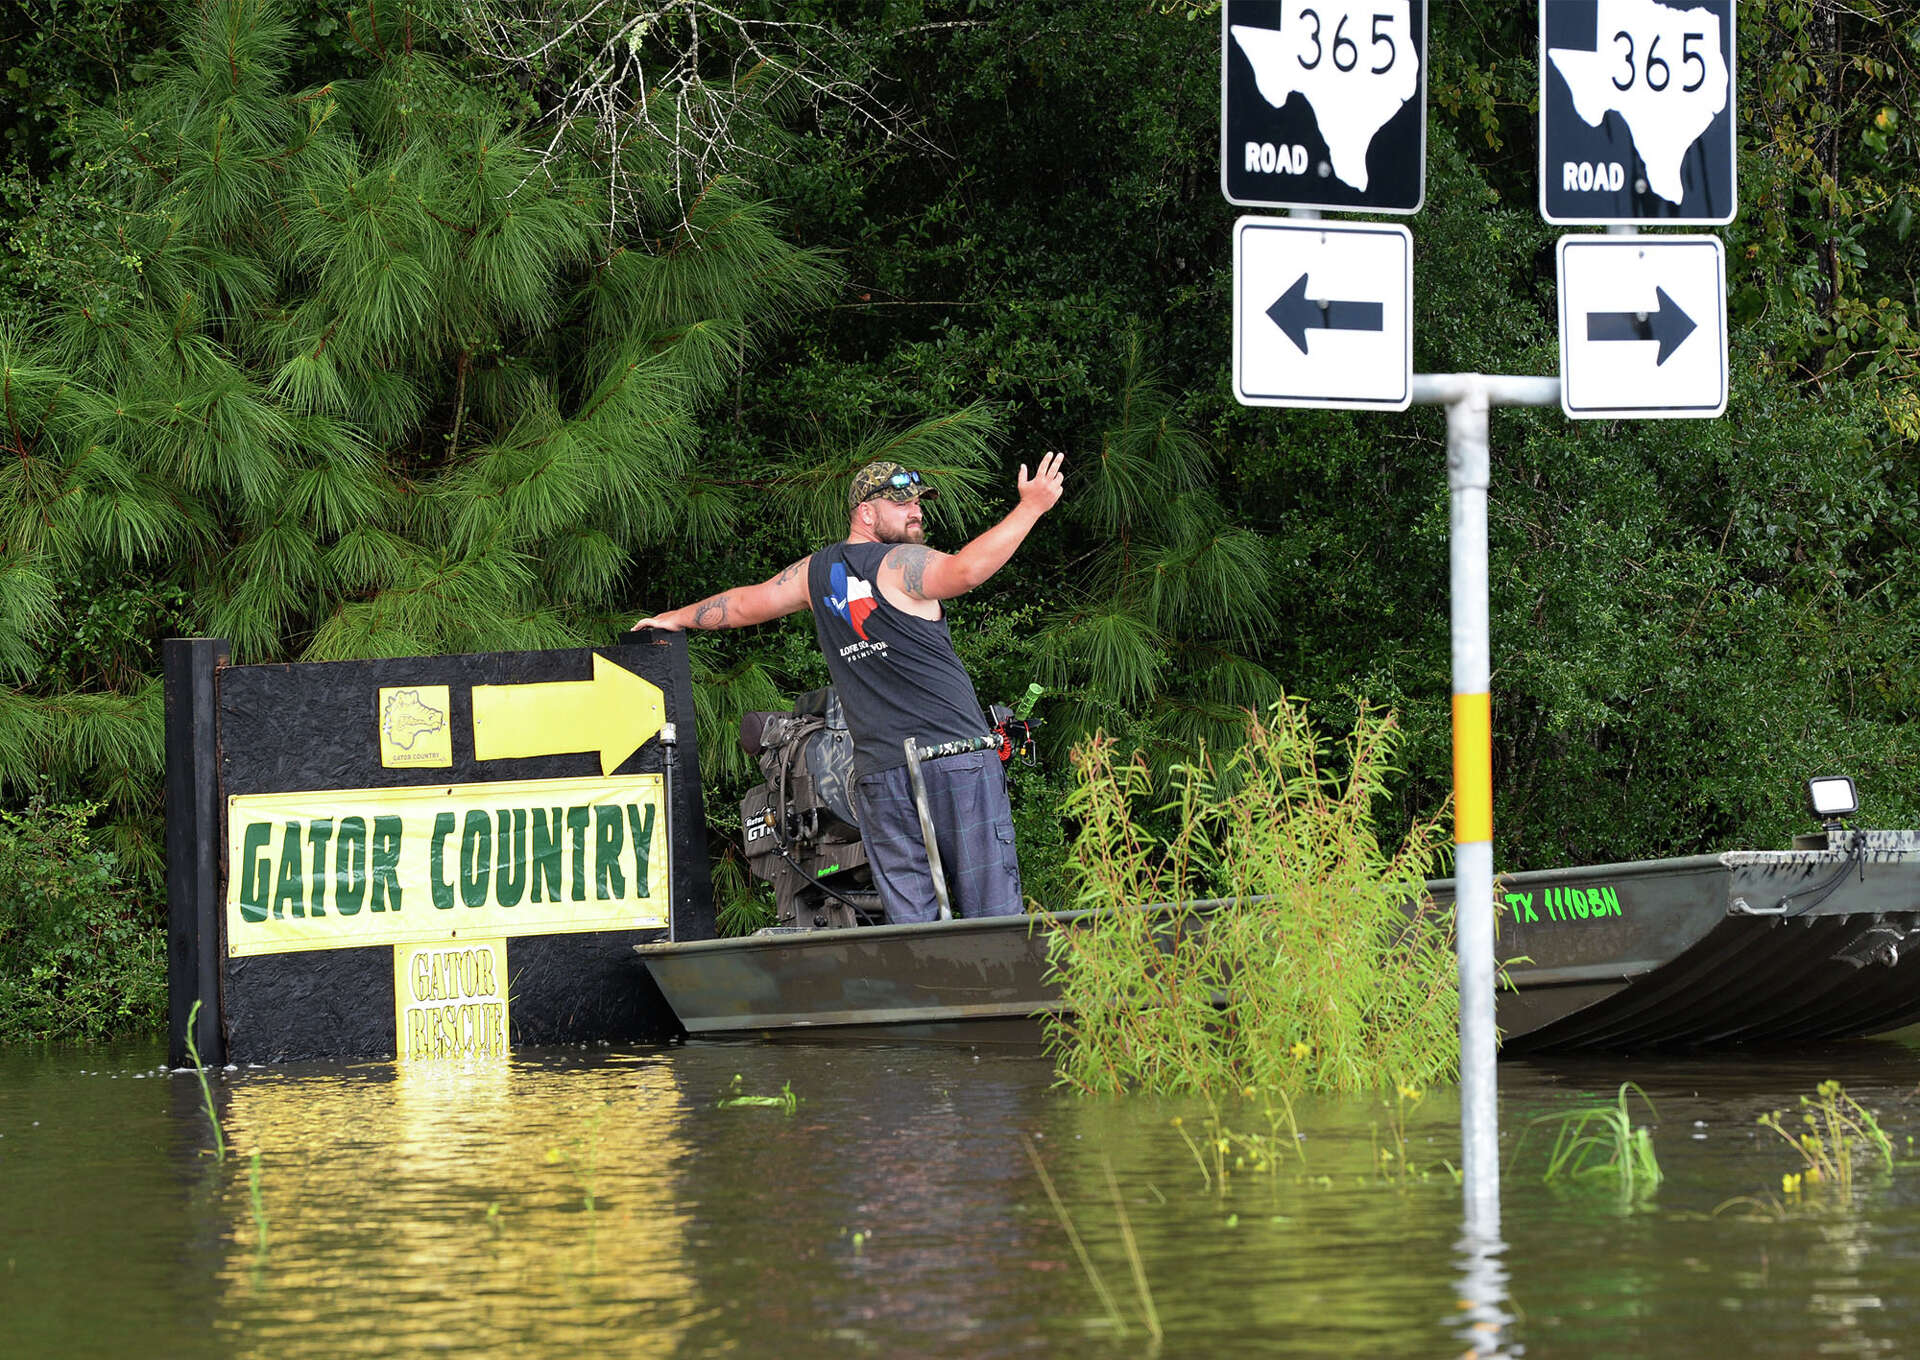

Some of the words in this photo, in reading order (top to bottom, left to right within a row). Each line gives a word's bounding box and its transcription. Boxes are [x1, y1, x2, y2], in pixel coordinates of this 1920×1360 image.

[1297, 8, 1395, 75] 365
[1611, 30, 1706, 93] 365
[1245, 142, 1309, 175] ROAD
[1563, 162, 1625, 192] ROAD
[413, 752, 440, 760] COUNTRY
[239, 814, 403, 923] GATOR
[430, 802, 656, 910] COUNTRY
[1504, 892, 1539, 924] TX
[411, 949, 496, 1002] GATOR
[408, 1003, 503, 1061] RESCUE
